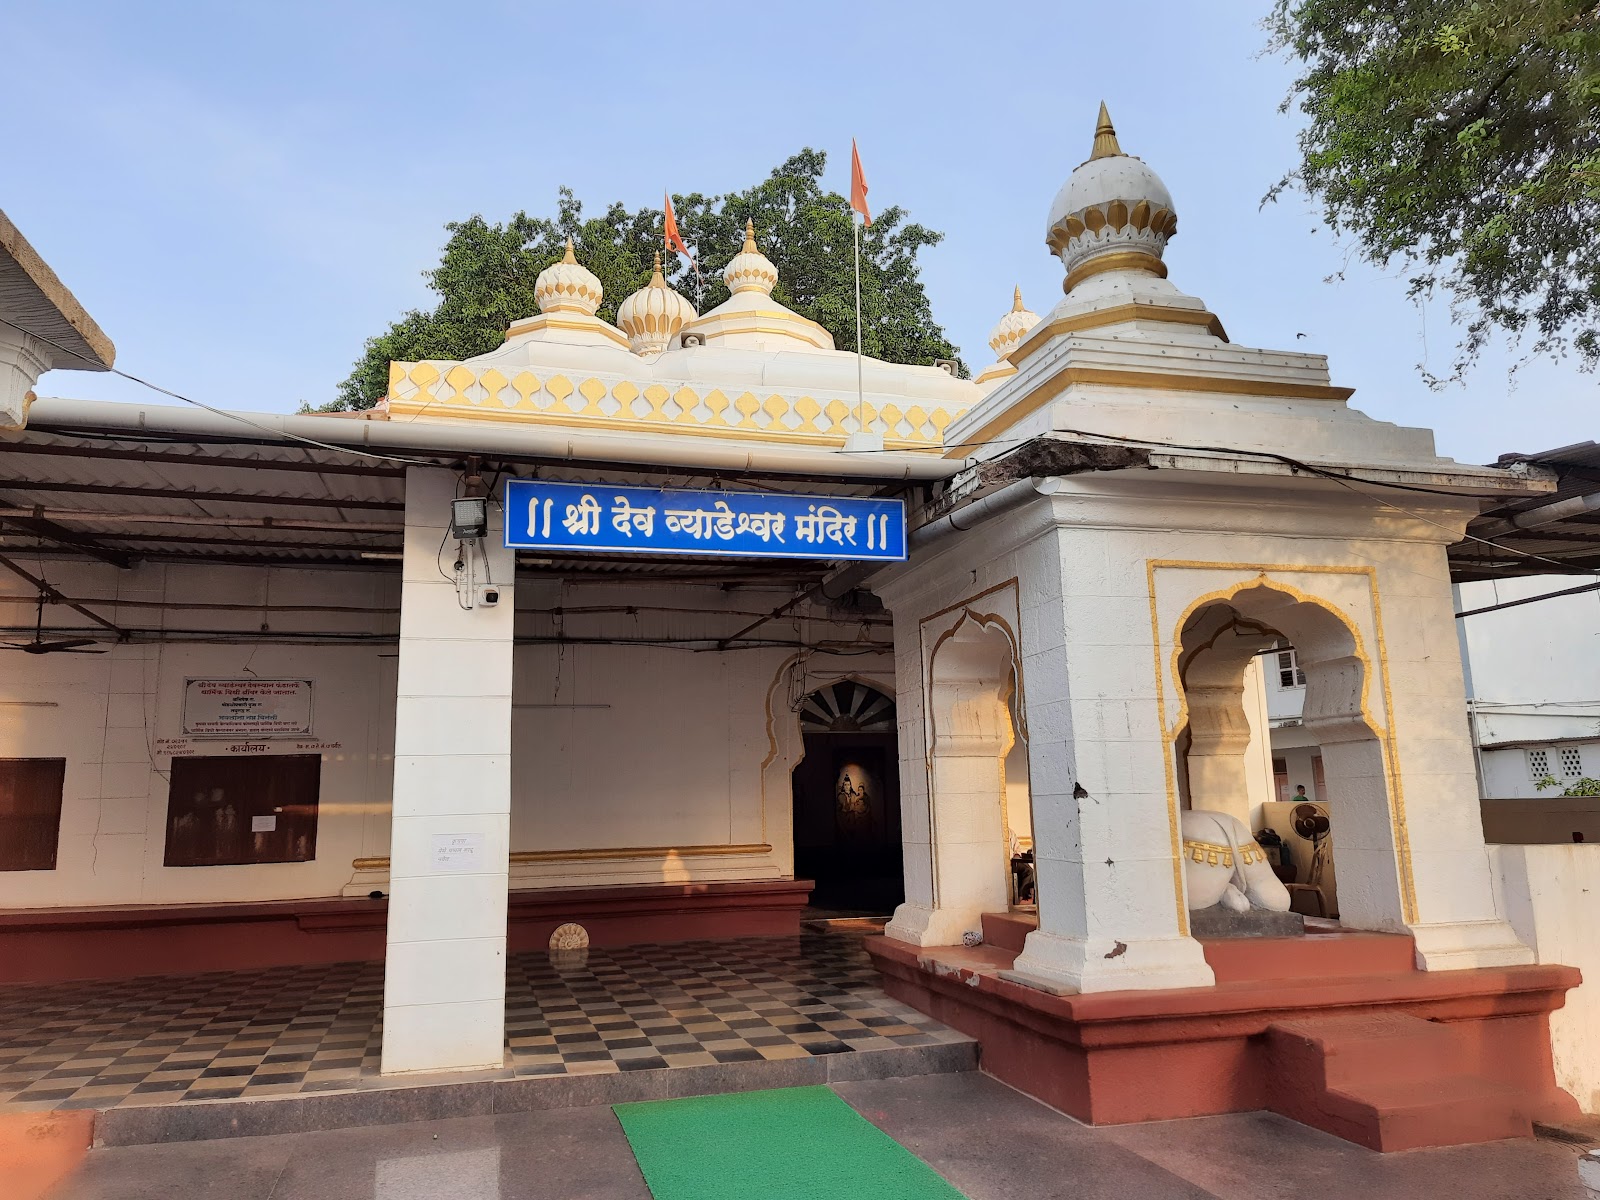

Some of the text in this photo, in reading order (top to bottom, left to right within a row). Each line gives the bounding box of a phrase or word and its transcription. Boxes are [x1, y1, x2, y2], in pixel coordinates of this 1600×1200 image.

[562, 494, 602, 536] श्री
[611, 495, 656, 538] देव
[664, 501, 786, 544] व्याडेश्वर
[795, 504, 857, 546] मंदिर
[230, 741, 267, 753] कार्यालय
